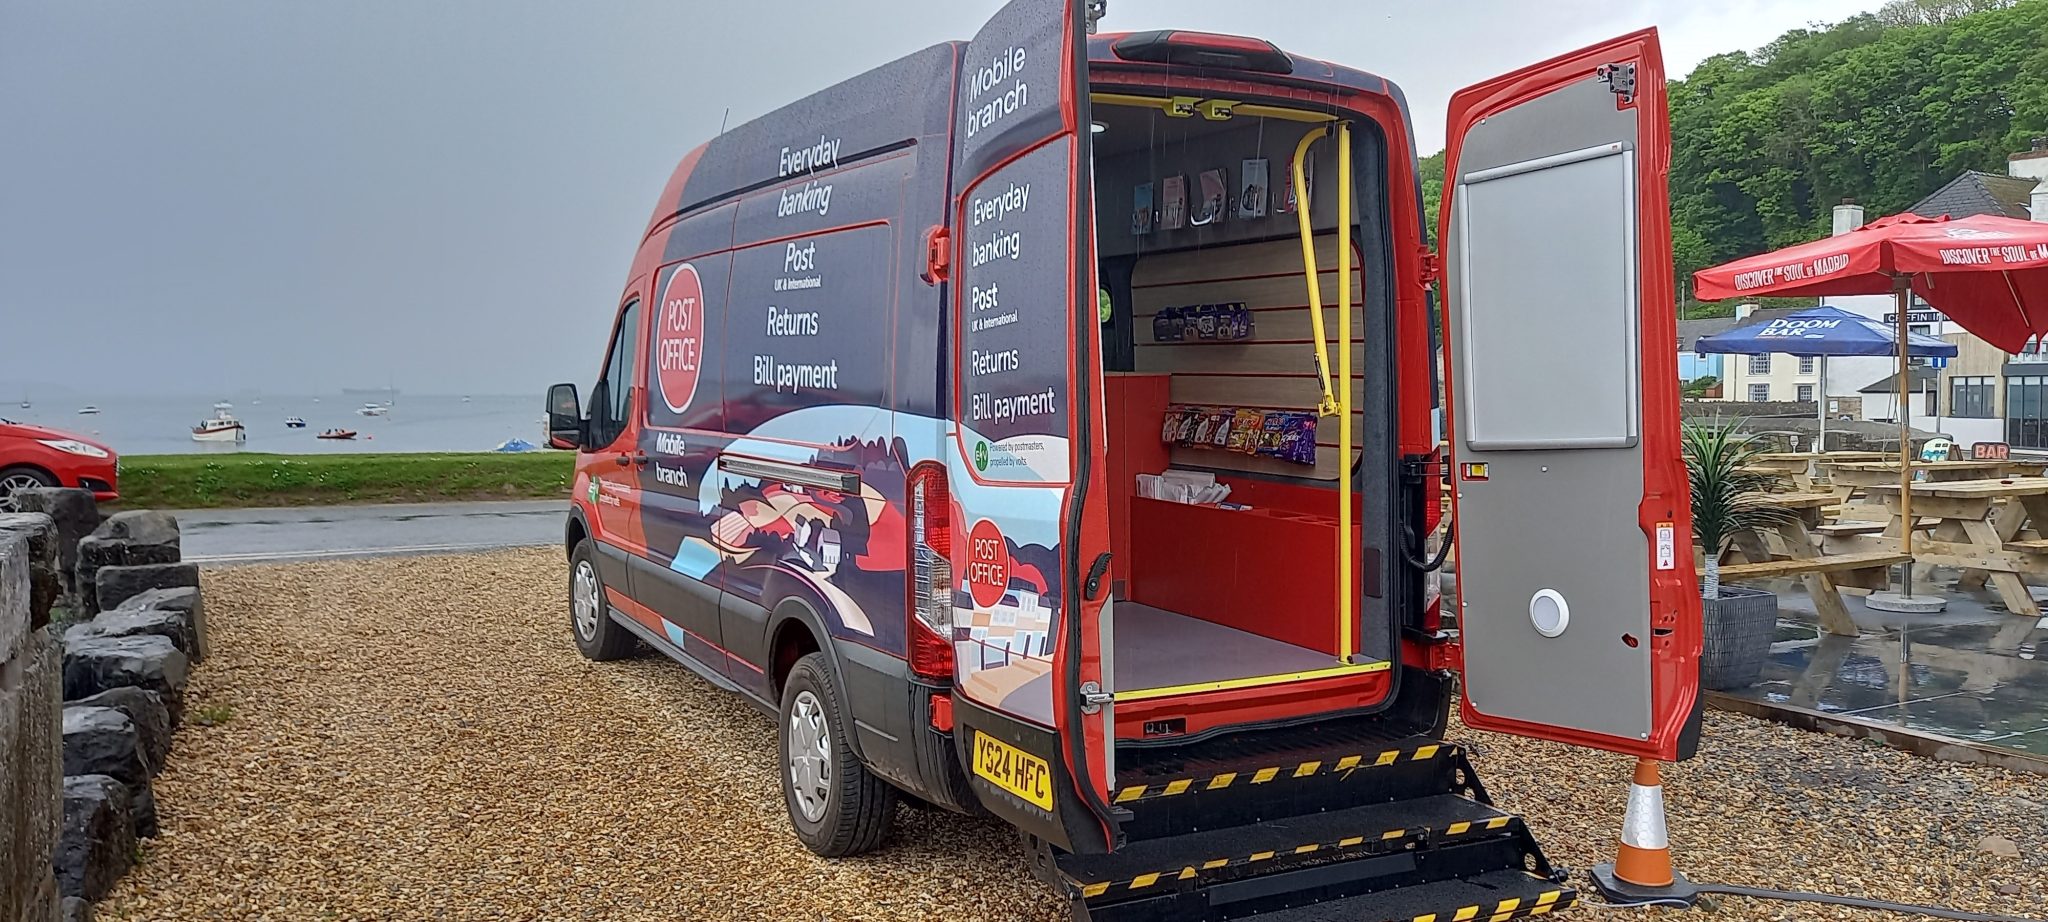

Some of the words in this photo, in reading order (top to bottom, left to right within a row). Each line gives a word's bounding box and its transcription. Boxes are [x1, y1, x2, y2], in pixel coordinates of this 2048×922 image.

[969, 47, 1026, 103] Mobile
[967, 79, 1028, 139] branch
[778, 135, 841, 180] Everyday
[777, 180, 833, 218] banking
[973, 183, 1030, 226] Everyday
[784, 241, 816, 273] Post
[972, 229, 1020, 267] banking
[1939, 248, 1991, 265] DISCOVER
[1989, 247, 2001, 256] THE
[2001, 245, 2030, 263] SOUL
[774, 280, 783, 292] UK
[788, 275, 821, 290] International
[1734, 268, 1775, 291] DISCOVER
[1783, 262, 1807, 282] SOUL
[1813, 254, 1849, 276] MADRID
[972, 282, 998, 313] Post
[667, 297, 695, 332] POST
[767, 306, 819, 336] Returns
[971, 320, 979, 333] UK
[984, 309, 1018, 330] International
[1768, 318, 1842, 329] DOOM
[1759, 327, 1806, 336] BAR
[661, 338, 696, 371] OFFICE
[972, 349, 1019, 376] Returns
[754, 355, 775, 386] Bill
[777, 359, 838, 394] payment
[973, 393, 991, 421] Bill
[994, 387, 1056, 425] payment
[656, 432, 686, 457] Mobile
[989, 442, 1007, 453] Powered
[1008, 442, 1014, 453] by
[1975, 444, 2009, 459] BAR
[656, 462, 689, 488] branch
[1009, 457, 1015, 467] by
[974, 538, 999, 561] POST
[969, 562, 1004, 588] OFFICE
[979, 736, 1011, 783] YS24
[1014, 754, 1046, 799] HFC
